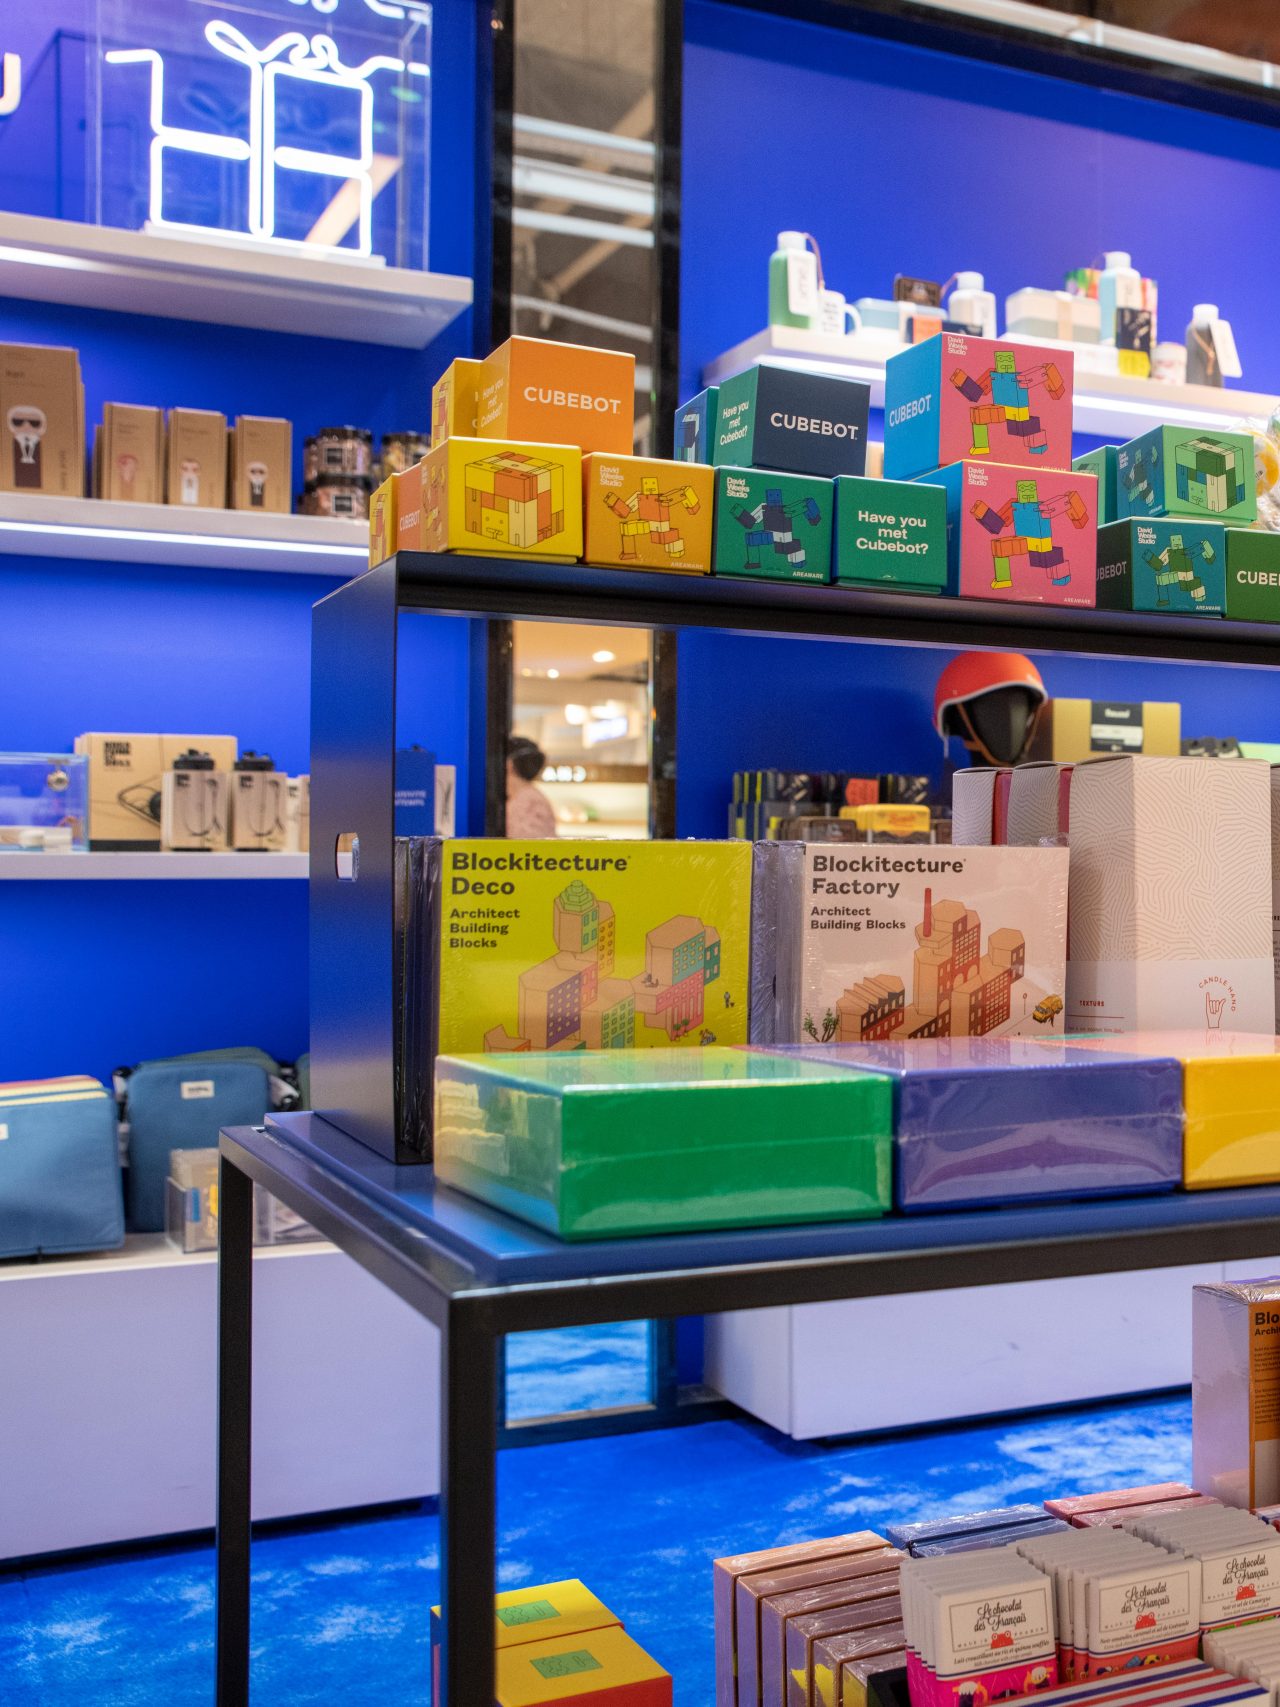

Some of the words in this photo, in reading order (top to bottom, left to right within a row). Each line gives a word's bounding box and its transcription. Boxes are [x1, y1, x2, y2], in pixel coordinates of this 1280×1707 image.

[523, 386, 622, 414] CUBEBOT
[722, 404, 737, 419] Have
[737, 400, 750, 416] you
[888, 394, 932, 427] CUBEBOT
[728, 416, 741, 429] met
[770, 412, 859, 440] CUBEBOT
[720, 426, 748, 446] Cubebot?
[967, 466, 985, 476] David
[726, 476, 746, 486] David
[726, 483, 750, 493] Weeks
[967, 479, 987, 487] Studio
[726, 489, 748, 499] Studio
[858, 510, 896, 524] Have
[899, 515, 927, 528] you
[878, 526, 908, 539] met
[856, 538, 929, 555] Cubebot?
[792, 570, 824, 580] AREAWARE
[1096, 561, 1128, 582] UBEBOT
[451, 852, 628, 872] Blockitecture
[812, 855, 964, 874] Blockitecture
[451, 876, 516, 896] Deco
[812, 877, 901, 898] Factory
[450, 907, 520, 919] Architect
[810, 906, 872, 917] Architect
[450, 922, 509, 936] Building
[810, 918, 862, 932] Building
[866, 919, 906, 930] Blocks
[450, 938, 498, 949] Blocks
[977, 1602, 992, 1620] Le
[992, 1598, 1022, 1615] chocolat
[974, 1619, 986, 1632] des
[987, 1612, 1027, 1632] Français
